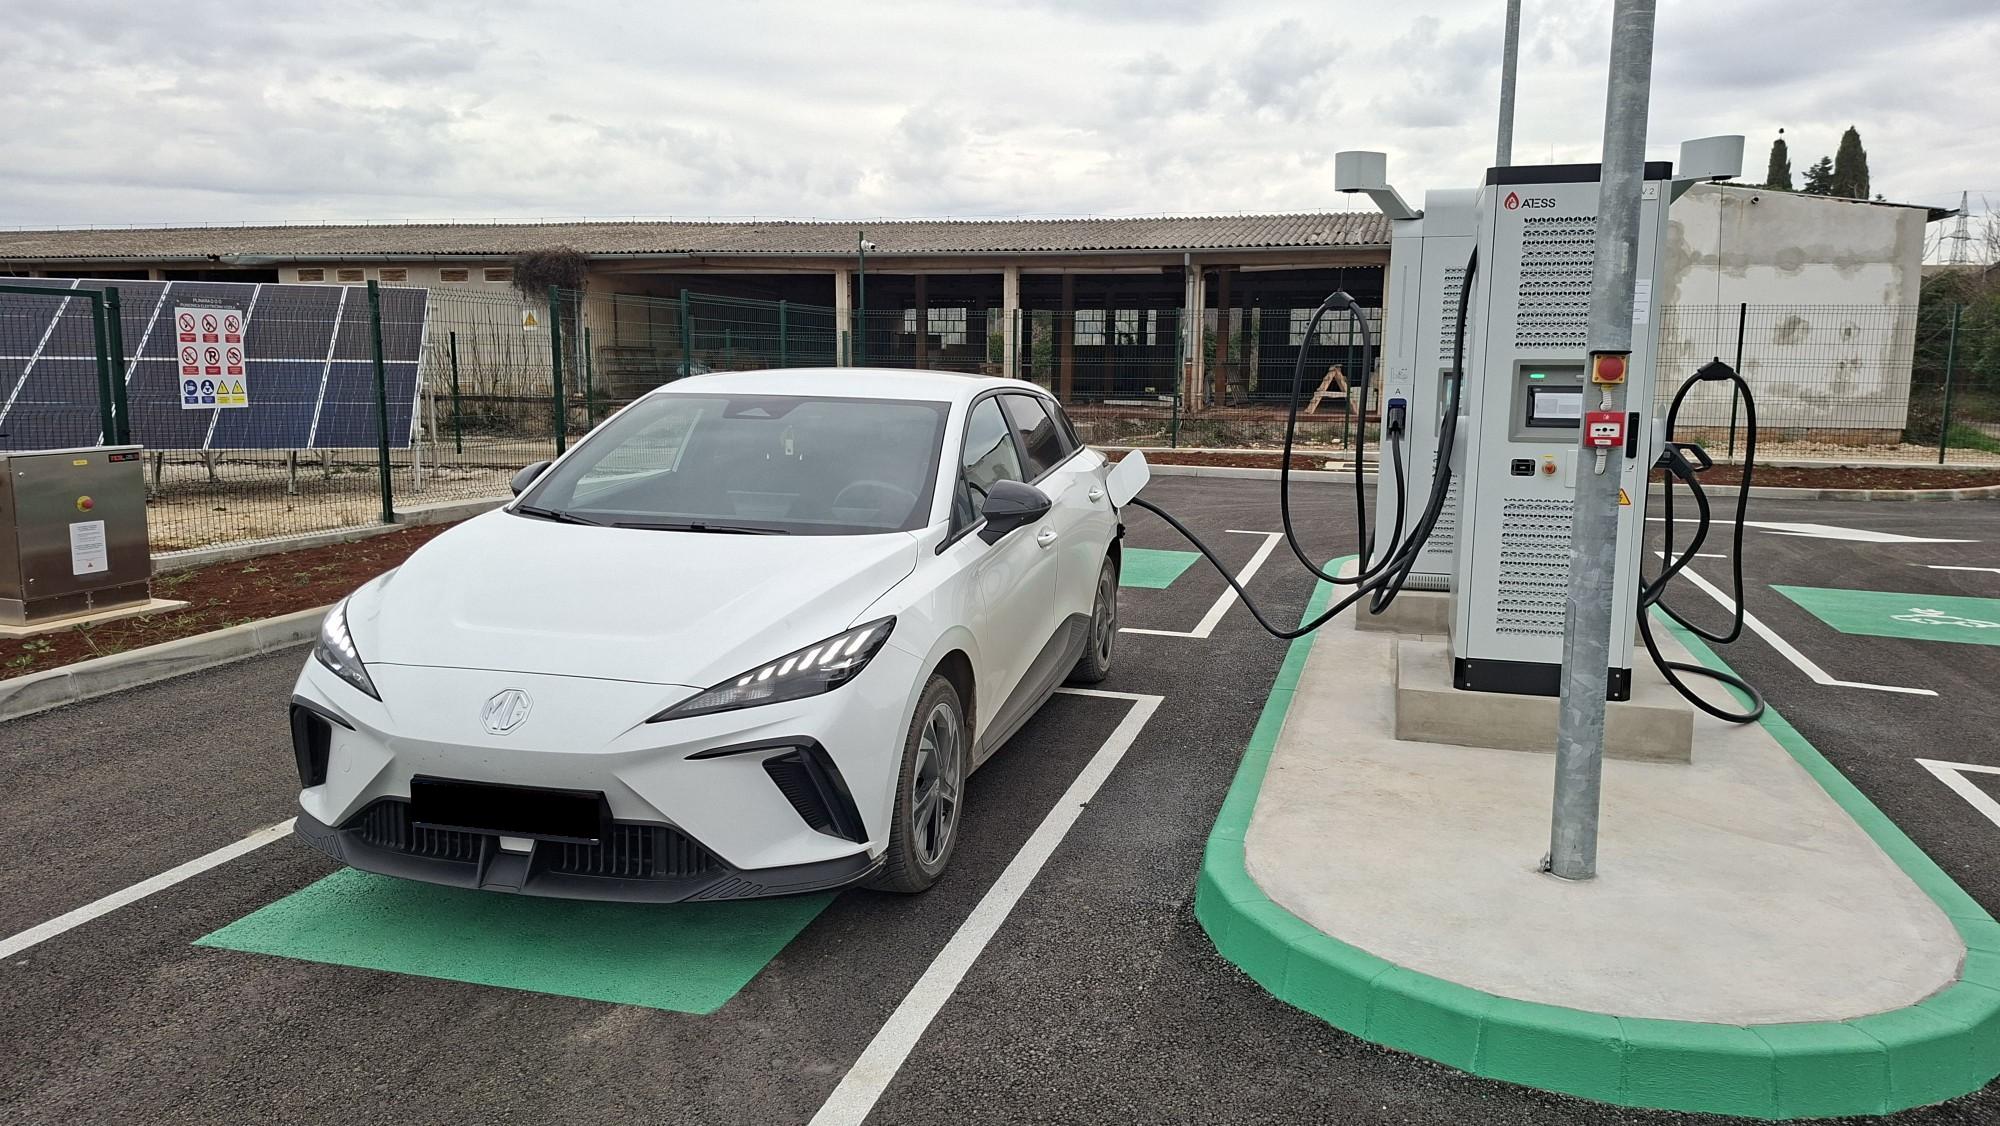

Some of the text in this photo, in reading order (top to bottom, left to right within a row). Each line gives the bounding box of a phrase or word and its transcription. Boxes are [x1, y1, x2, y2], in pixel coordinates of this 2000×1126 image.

[1650, 187, 1655, 195] 2
[1521, 198, 1556, 209] ATESS
[483, 689, 531, 732] MG
